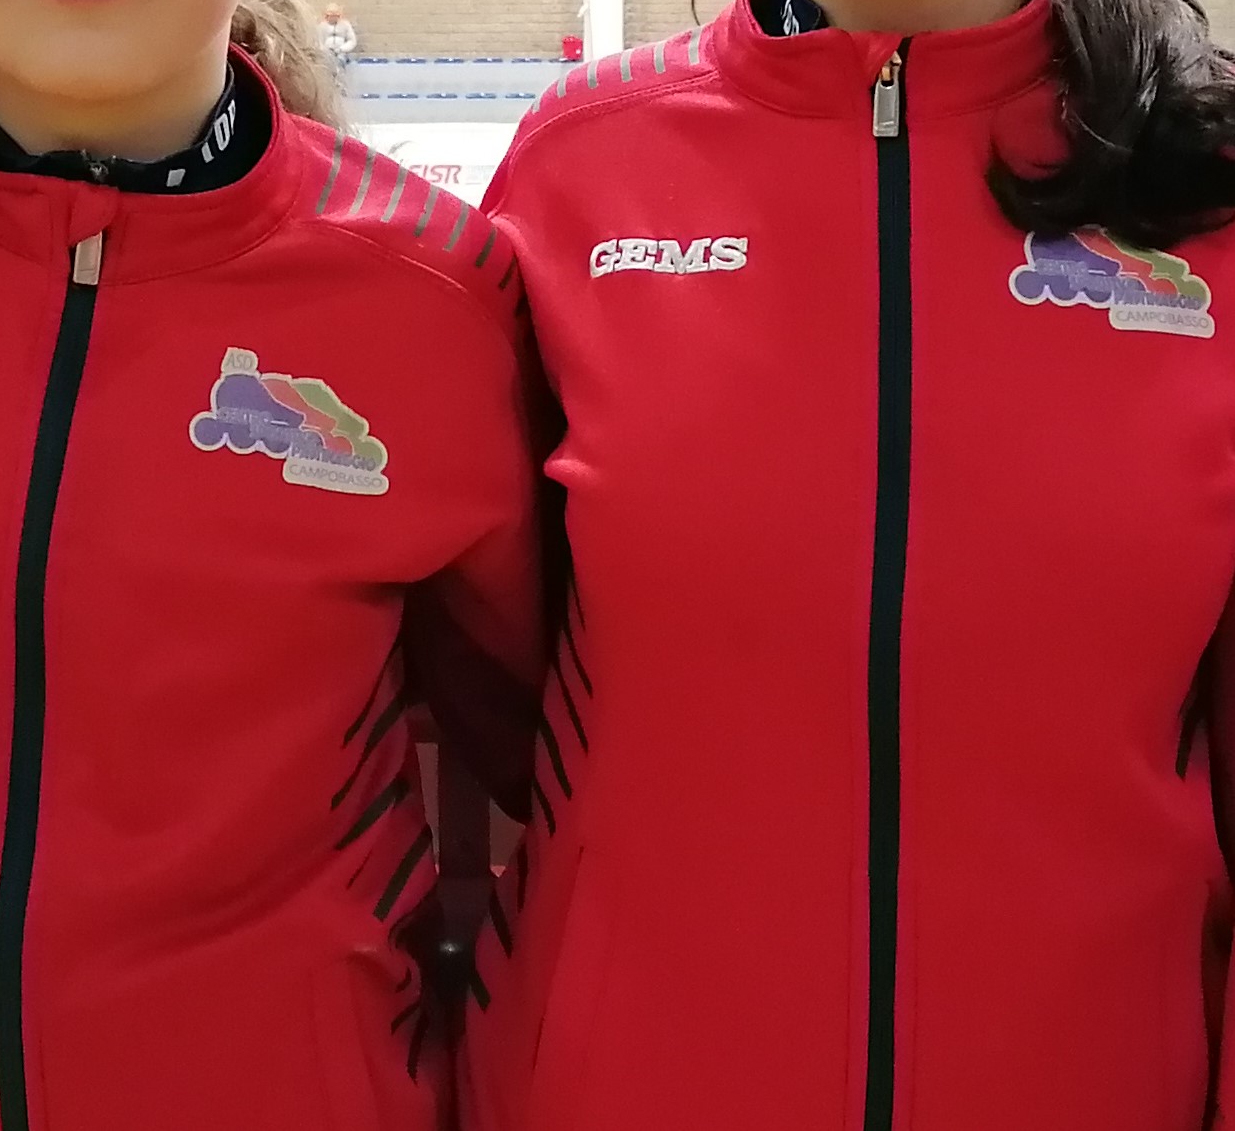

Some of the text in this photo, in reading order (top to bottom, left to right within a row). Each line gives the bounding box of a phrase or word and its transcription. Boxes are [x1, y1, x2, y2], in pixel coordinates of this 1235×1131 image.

[590, 236, 749, 279] GEMS
[1115, 310, 1209, 328] CAMPOBASSO
[226, 352, 255, 371] ASD
[288, 464, 383, 488] CAMPOBASSO
